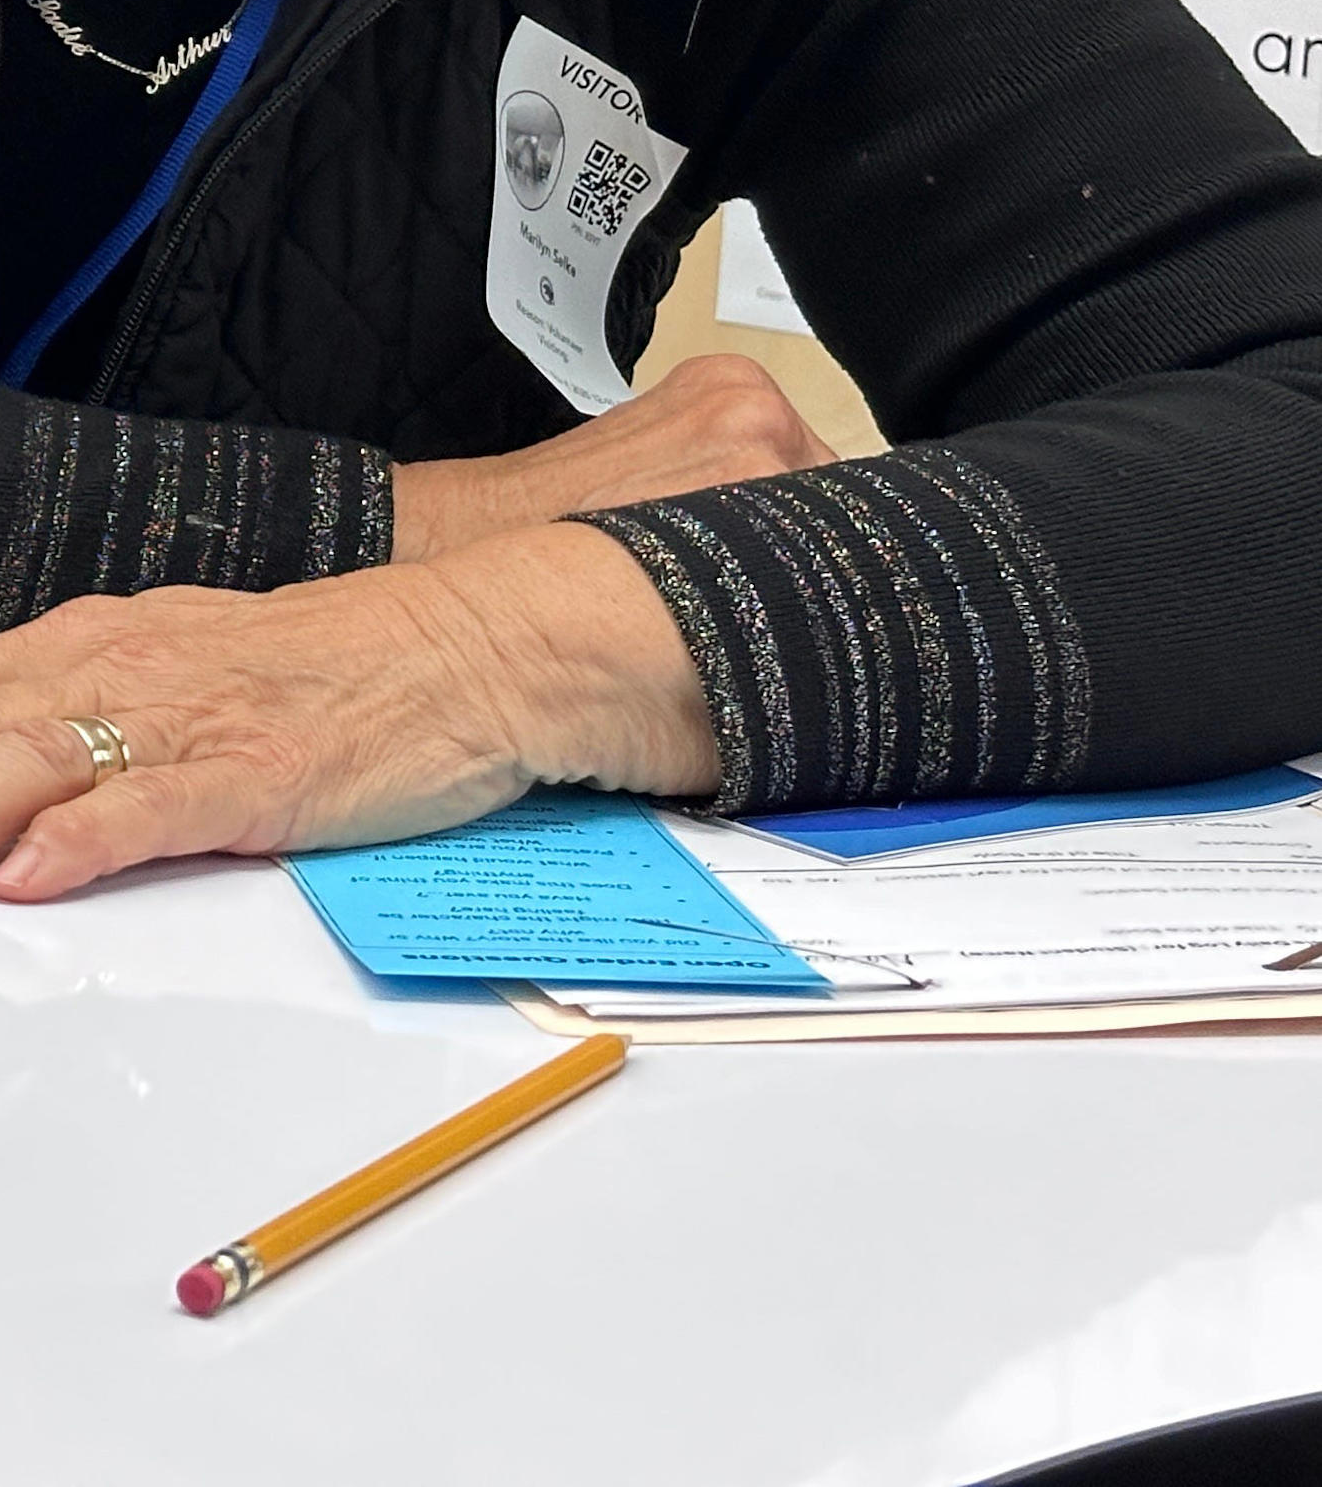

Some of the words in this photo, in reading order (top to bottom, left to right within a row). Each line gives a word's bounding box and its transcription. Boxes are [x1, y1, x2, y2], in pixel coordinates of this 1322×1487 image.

[145, 23, 232, 95] Arthur
[560, 54, 645, 126] VISITOR
[490, 843, 530, 852] you
[391, 854, 468, 864] happen
[472, 856, 534, 865] would
[350, 875, 372, 883] of
[374, 876, 428, 884] think
[432, 876, 471, 884] you
[475, 878, 532, 887] make
[536, 881, 576, 889] this
[580, 882, 633, 891] Does
[494, 892, 534, 900] you
[538, 894, 592, 903] Have
[377, 912, 404, 920] be
[410, 913, 512, 922] character
[516, 915, 552, 923] the
[466, 934, 532, 944] story?
[537, 936, 573, 944] the
[577, 937, 615, 945] like
[618, 936, 660, 945] you
[664, 939, 700, 947] Did
[401, 954, 568, 965] Questions
[576, 957, 678, 967] Ended
[683, 959, 771, 969] Open
